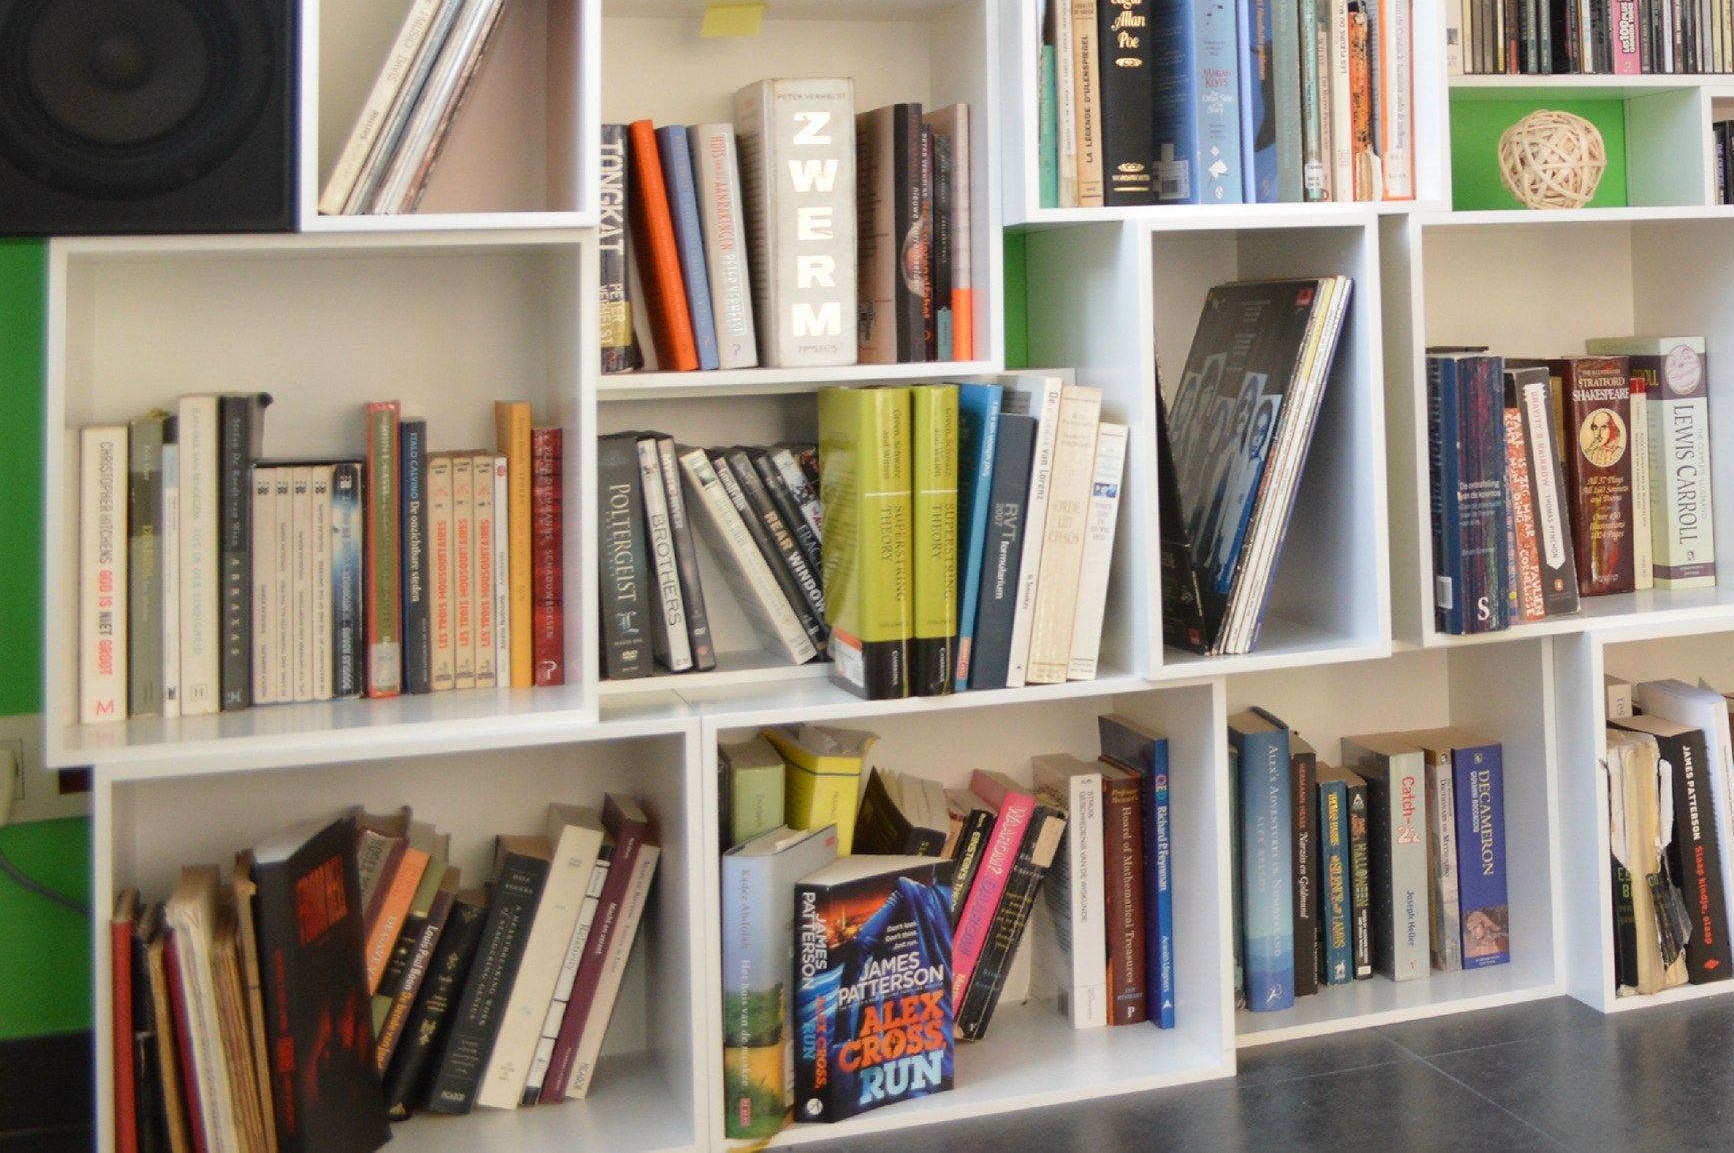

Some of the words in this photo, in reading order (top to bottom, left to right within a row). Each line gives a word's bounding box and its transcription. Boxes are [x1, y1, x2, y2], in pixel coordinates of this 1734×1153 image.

[1111, 10, 1145, 31] Allan
[1117, 30, 1140, 49] Poe
[1203, 68, 1231, 79] MARIAN
[1205, 77, 1229, 88] KEYES
[1084, 103, 1092, 143] LEGENDE
[1086, 147, 1093, 164] LA
[600, 138, 623, 255] TONGKAT
[788, 111, 841, 337] ZWERM
[611, 284, 625, 324] PETER
[1572, 387, 1630, 402] SHAKESPEARE
[1577, 376, 1625, 388] STRATFORD
[410, 432, 419, 458] ITALO
[1673, 404, 1695, 461] LEWIS
[99, 441, 113, 512] CHRISTOPHER
[410, 460, 419, 499] CALVINO
[1036, 469, 1048, 500] Lorenz
[411, 501, 421, 514] De
[994, 502, 1004, 528] 2007
[1002, 502, 1019, 542] RVT
[1675, 464, 1698, 545] CARROLL
[99, 514, 113, 564] HITCHENS
[410, 515, 421, 570] onzichtbare
[609, 483, 636, 602] POLTERGEIST
[881, 507, 892, 562] THEORY
[931, 504, 942, 561] THEORY
[943, 502, 955, 599] SUPERSTRING
[651, 514, 682, 626] BROTHERS
[764, 510, 792, 550] REAR
[788, 550, 825, 613] WINDOW
[893, 505, 905, 603] SUPERSTRING
[995, 540, 1009, 600] formularium
[99, 570, 112, 592] GOD
[411, 572, 421, 602] steden
[99, 596, 112, 607] IS
[99, 611, 113, 636] NIET
[98, 639, 112, 675] GROOT
[1268, 745, 1279, 782] ALEX'S
[1683, 745, 1696, 779] JAMES
[1122, 806, 1133, 838] Hoard
[1156, 805, 1167, 842] Richard
[1477, 769, 1494, 876] DECAMERON
[1687, 780, 1701, 841] PATTERSON
[956, 831, 980, 880] EINSTEIN'S
[987, 805, 1027, 875] WAAROM?
[1157, 849, 1169, 891] Feynman
[1353, 843, 1368, 907] HALLOWEEN
[950, 882, 966, 912] THEO
[1122, 854, 1134, 928] Mathematical
[1298, 876, 1309, 919] Goldmund
[1407, 890, 1416, 920] Joseph
[420, 925, 439, 948] Louis
[567, 924, 590, 971] Relativity
[801, 890, 816, 989] PATTERSON
[815, 913, 828, 971] JAMES
[1407, 921, 1416, 946] Heller
[413, 949, 430, 968] Paul
[740, 959, 753, 980] Het
[860, 951, 920, 983] JAMES
[1124, 930, 1135, 983] Treasures
[405, 968, 423, 991] Boon
[740, 982, 753, 1006] huis
[838, 965, 944, 1010] PATTERSON
[740, 1007, 750, 1028] van
[816, 996, 827, 1037] ALEX
[858, 991, 944, 1037] ALEX
[802, 1022, 816, 1060] RUN
[839, 1022, 946, 1073] CROSS
[815, 1039, 828, 1086] CROSS
[858, 1050, 945, 1105] RUN
